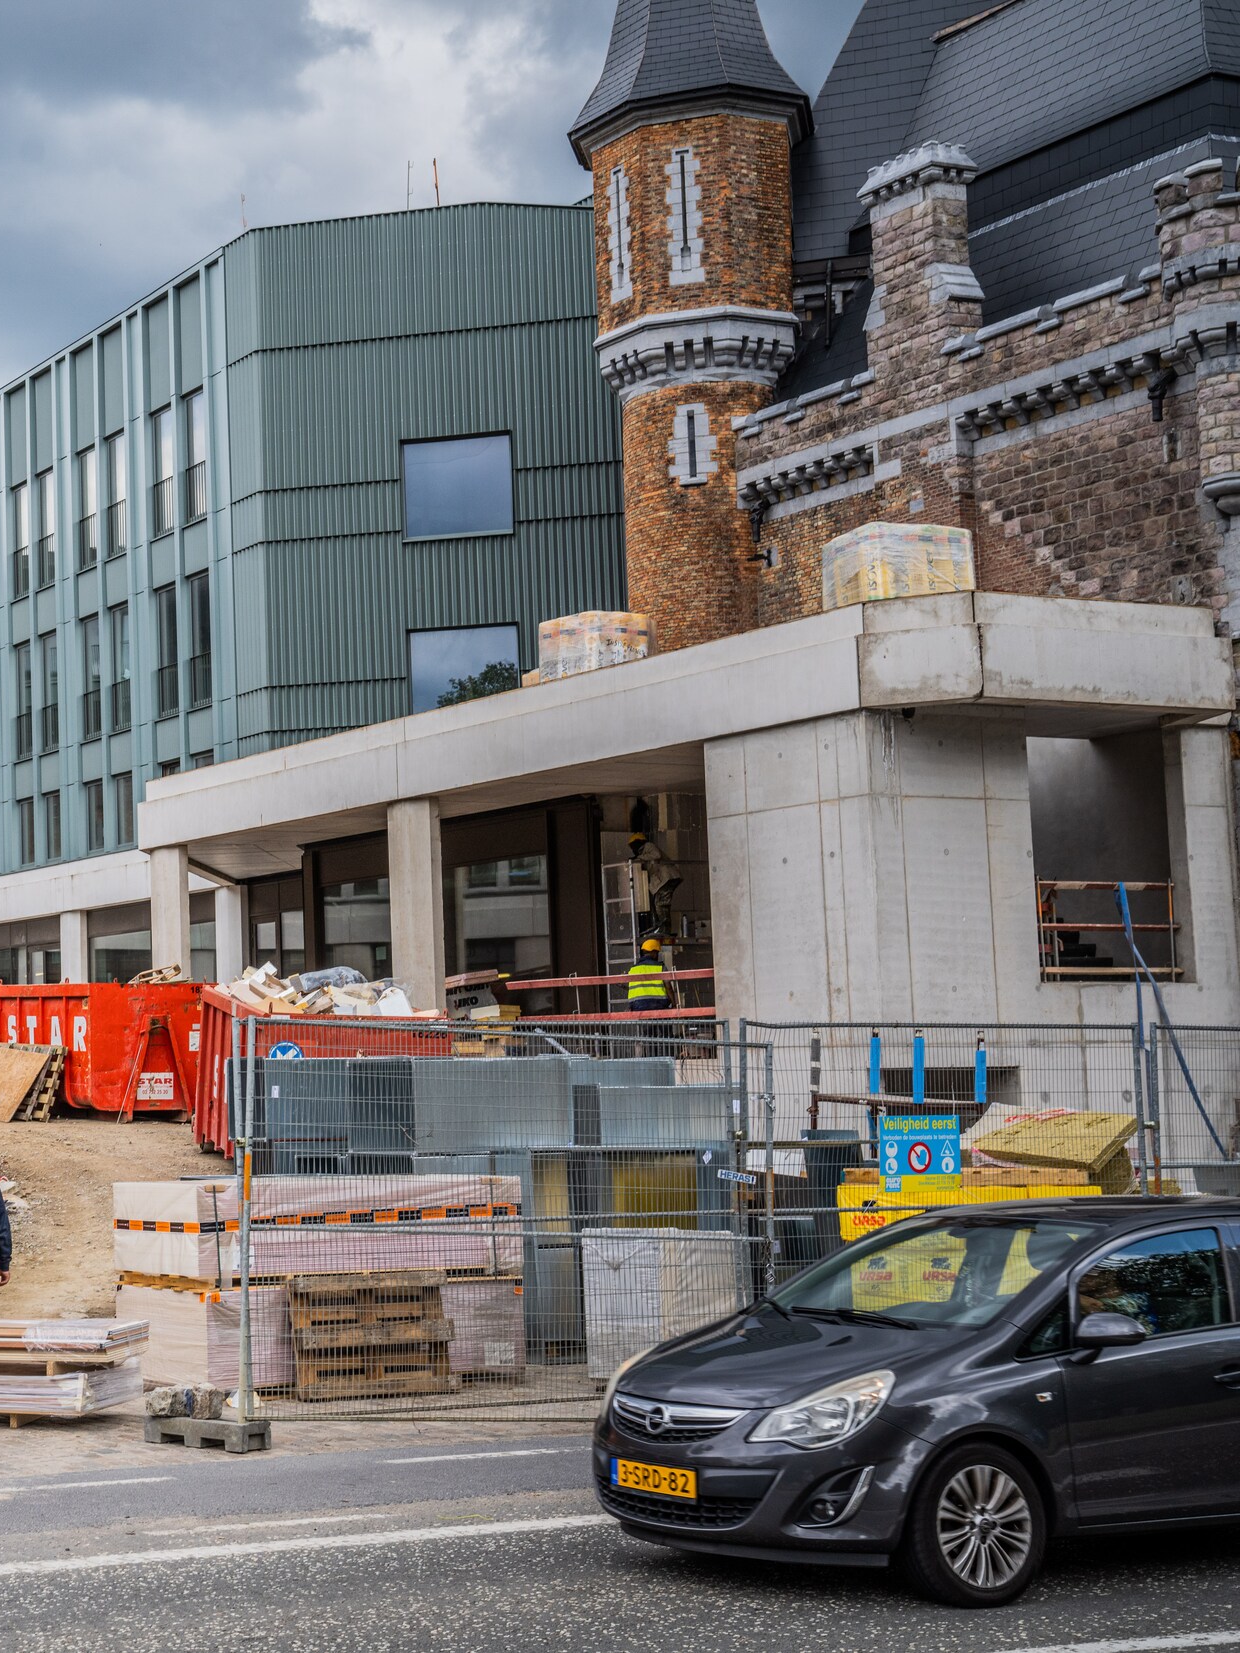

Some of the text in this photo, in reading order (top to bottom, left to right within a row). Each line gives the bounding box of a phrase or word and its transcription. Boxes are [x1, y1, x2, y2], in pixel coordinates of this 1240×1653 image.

[6, 1014, 87, 1052] STAR
[139, 1077, 173, 1085] STAR
[882, 1117, 957, 1133] Veiligheid eerst
[720, 1171, 751, 1182] HERAS
[621, 1463, 691, 1494] 3-SRD-82
